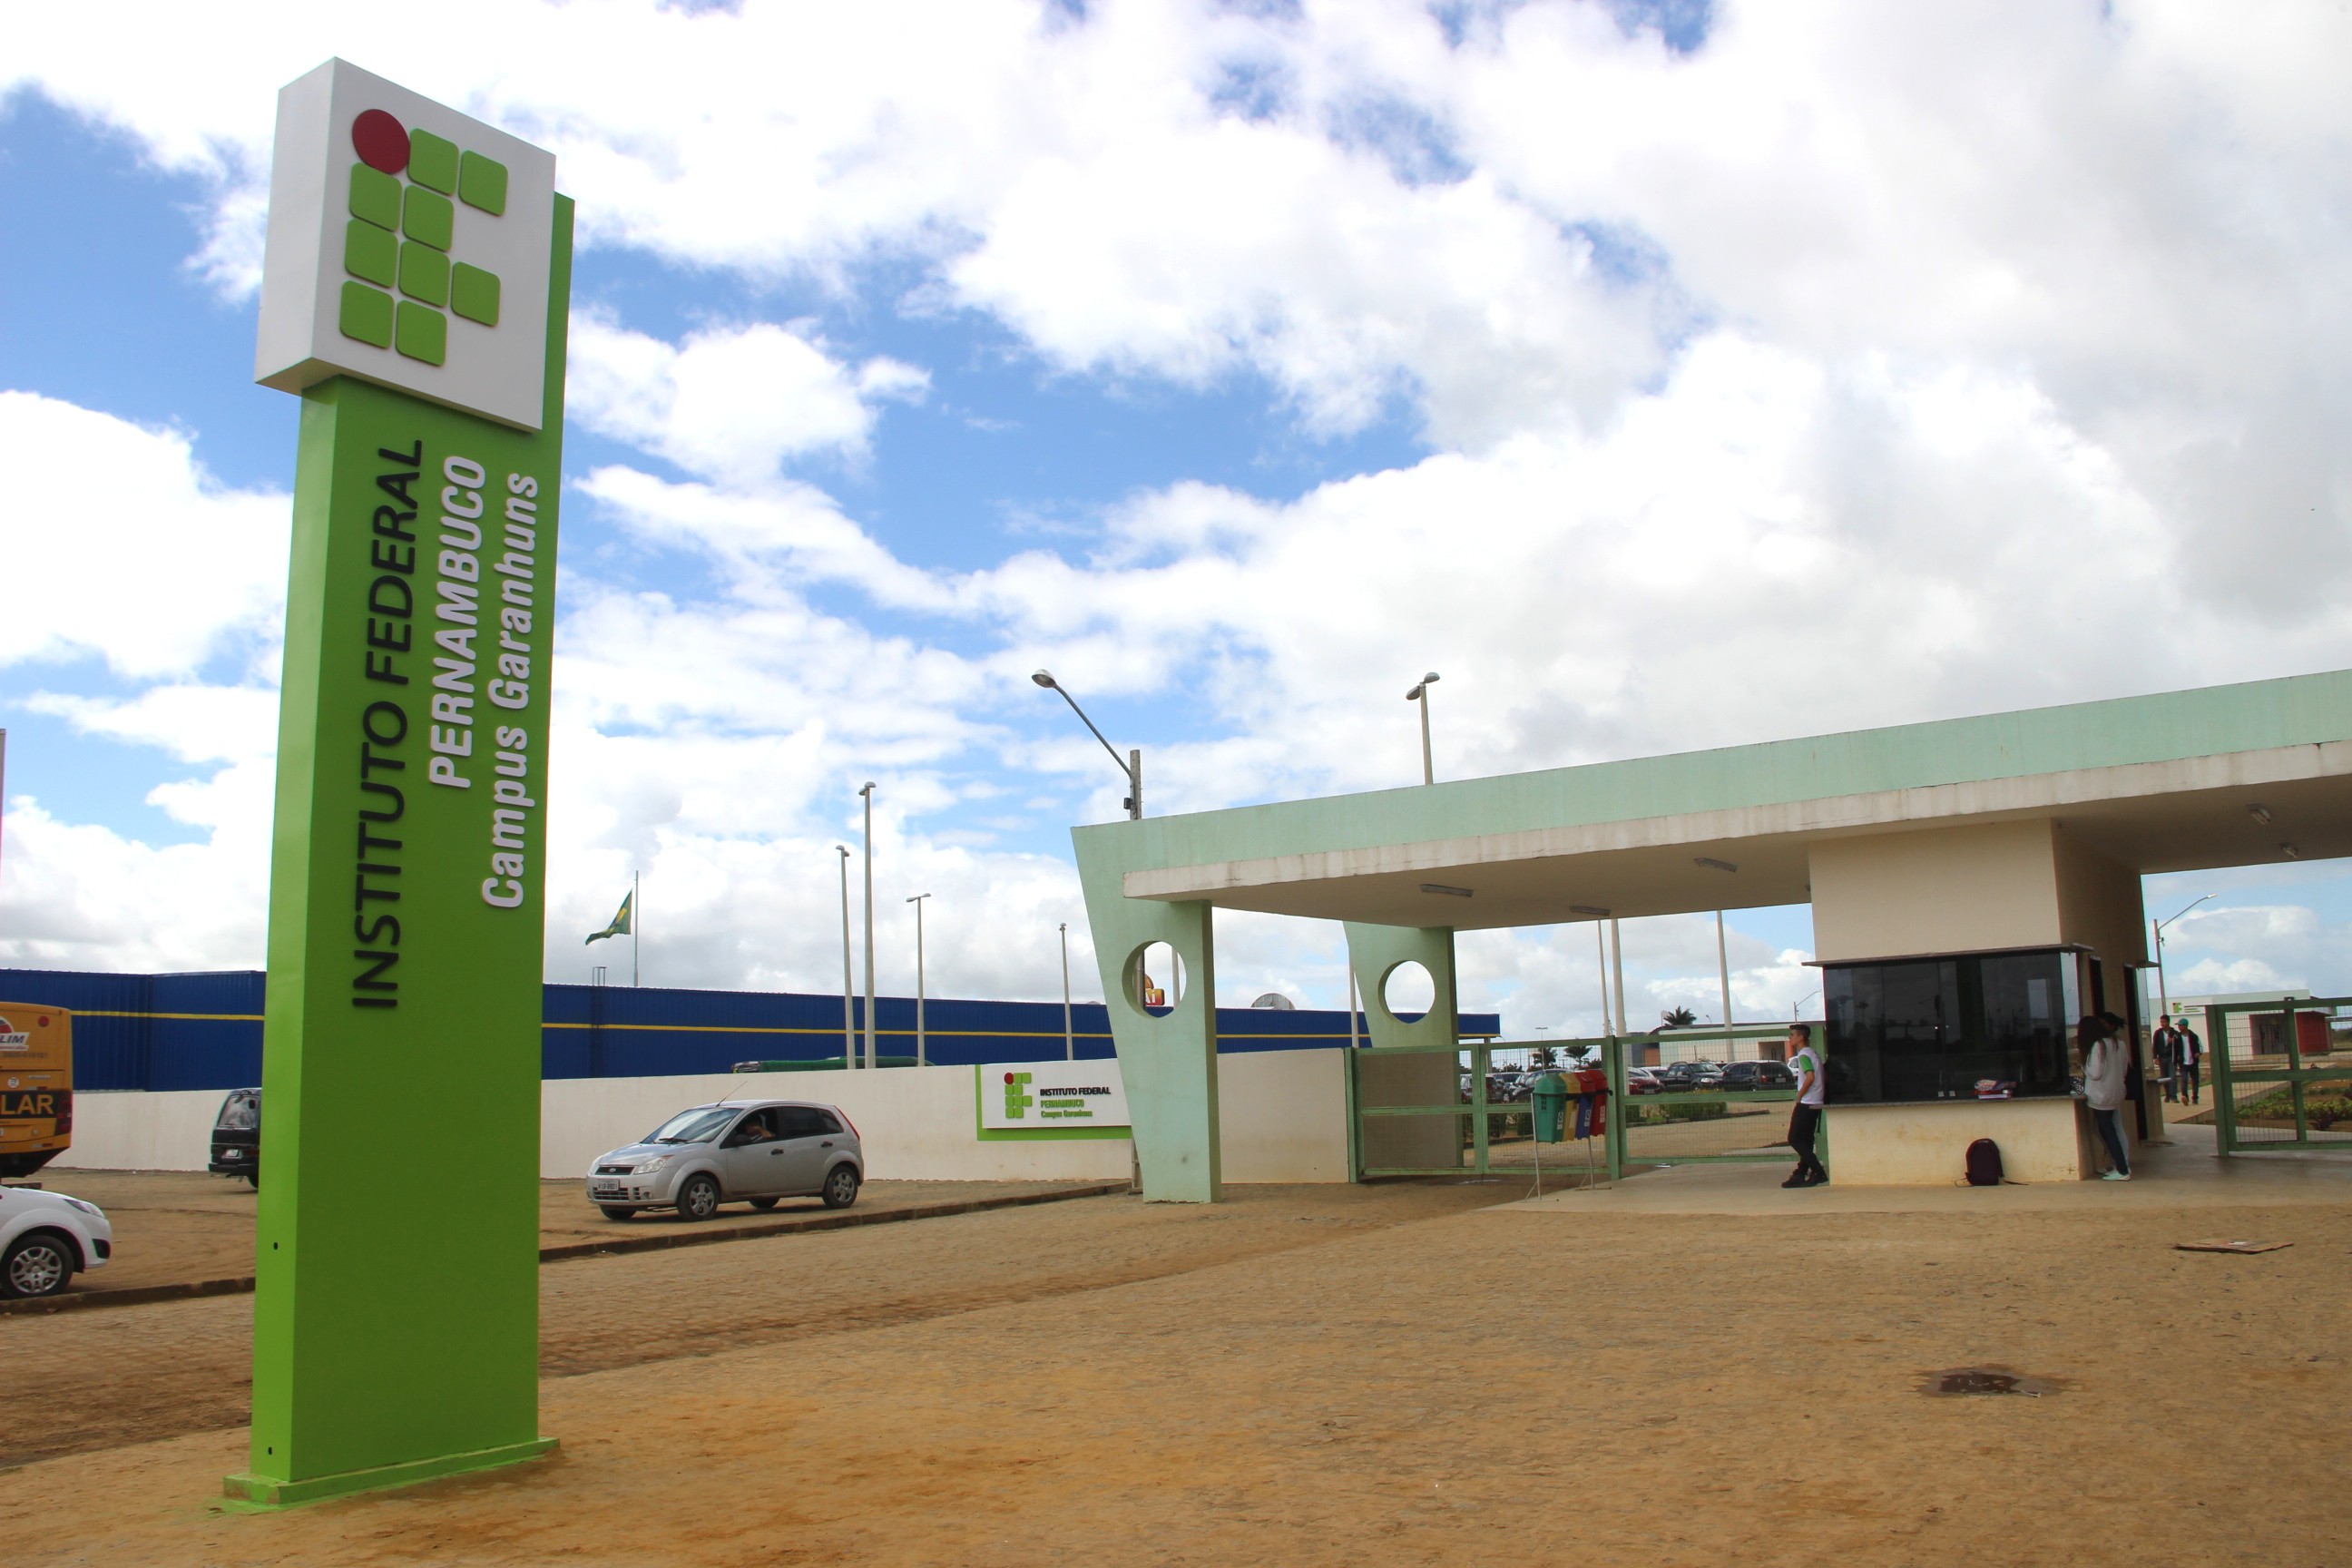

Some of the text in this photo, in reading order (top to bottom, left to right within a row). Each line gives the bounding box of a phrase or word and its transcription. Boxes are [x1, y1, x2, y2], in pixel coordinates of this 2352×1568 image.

[429, 456, 485, 789] PERNAMBUCO
[482, 472, 538, 909] Campus Garanhuns
[353, 440, 422, 1008] INSTITUTO FEDERAL
[0, 1094, 54, 1114] LAR
[1040, 1088, 1077, 1096] INSTITUTO
[1041, 1099, 1084, 1108] PERNAMBUCO
